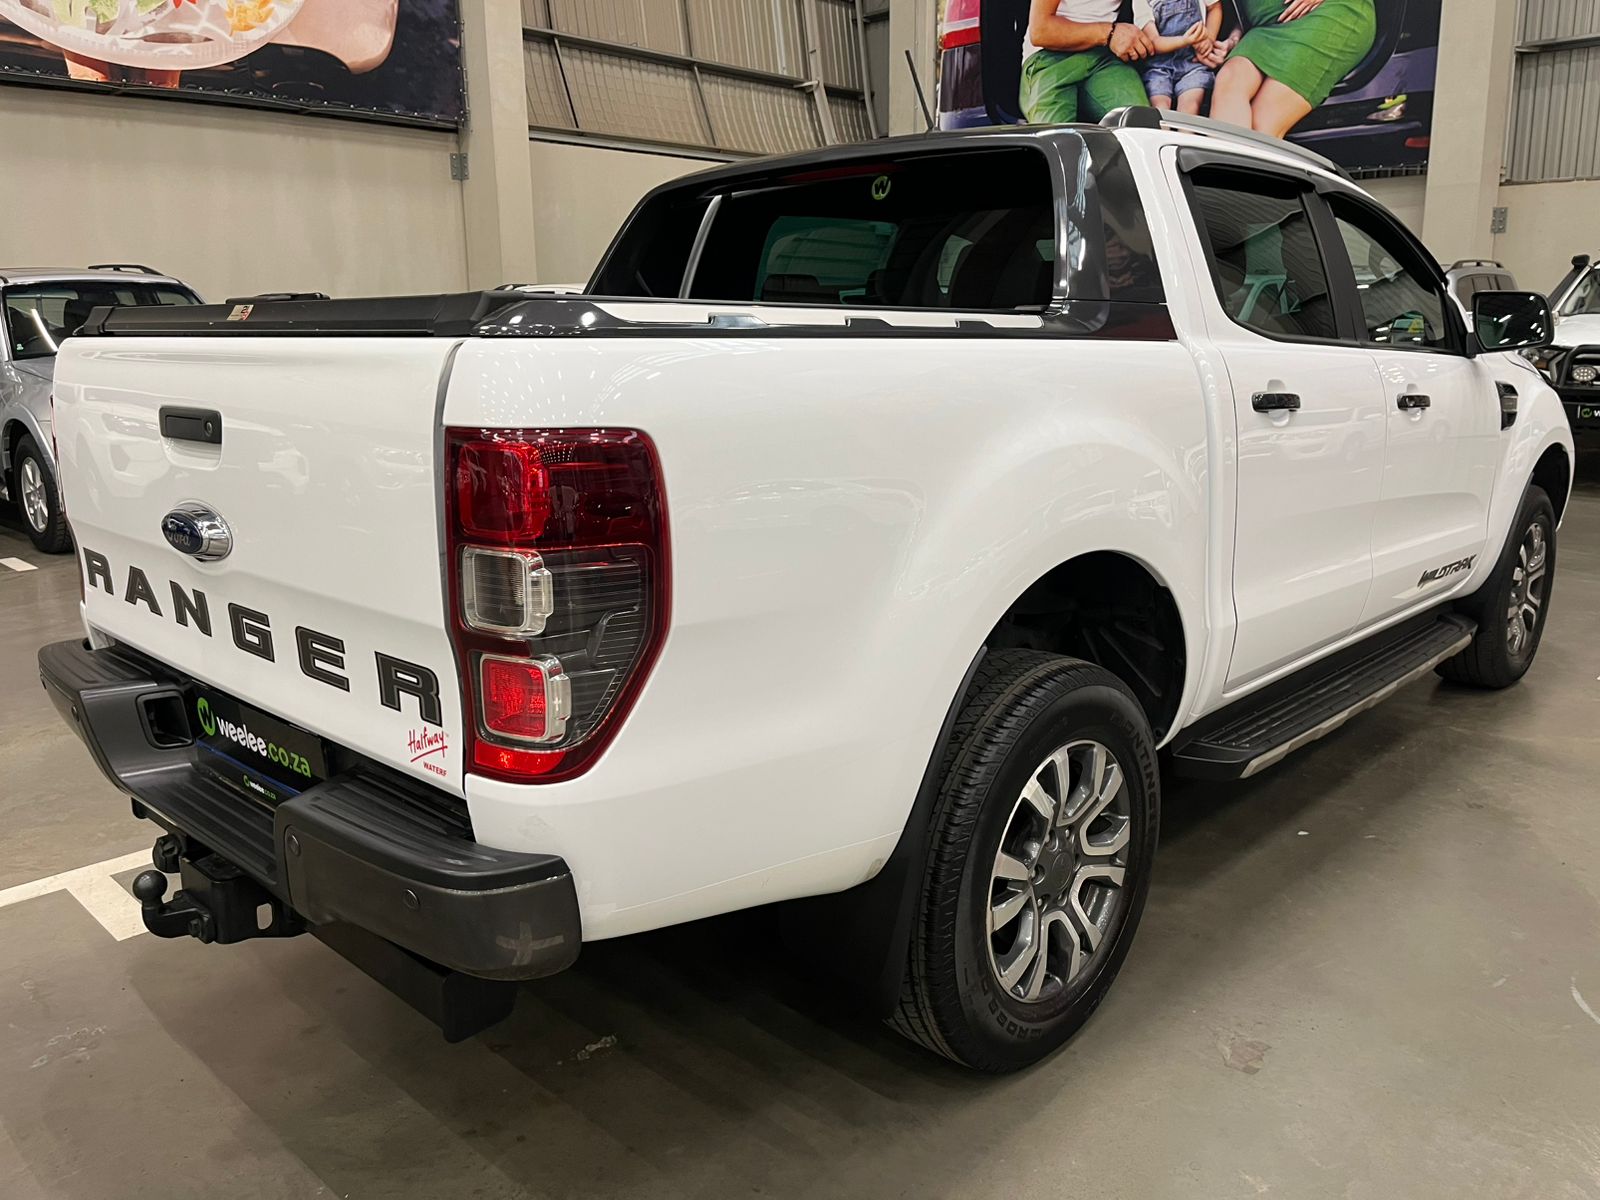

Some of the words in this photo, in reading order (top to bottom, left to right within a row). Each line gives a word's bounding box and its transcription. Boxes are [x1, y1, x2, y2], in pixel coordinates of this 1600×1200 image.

[1417, 554, 1477, 588] WILDTRAK
[83, 546, 443, 728] RANGER
[216, 716, 312, 778] weelee.co.za
[407, 726, 447, 760] Halfway
